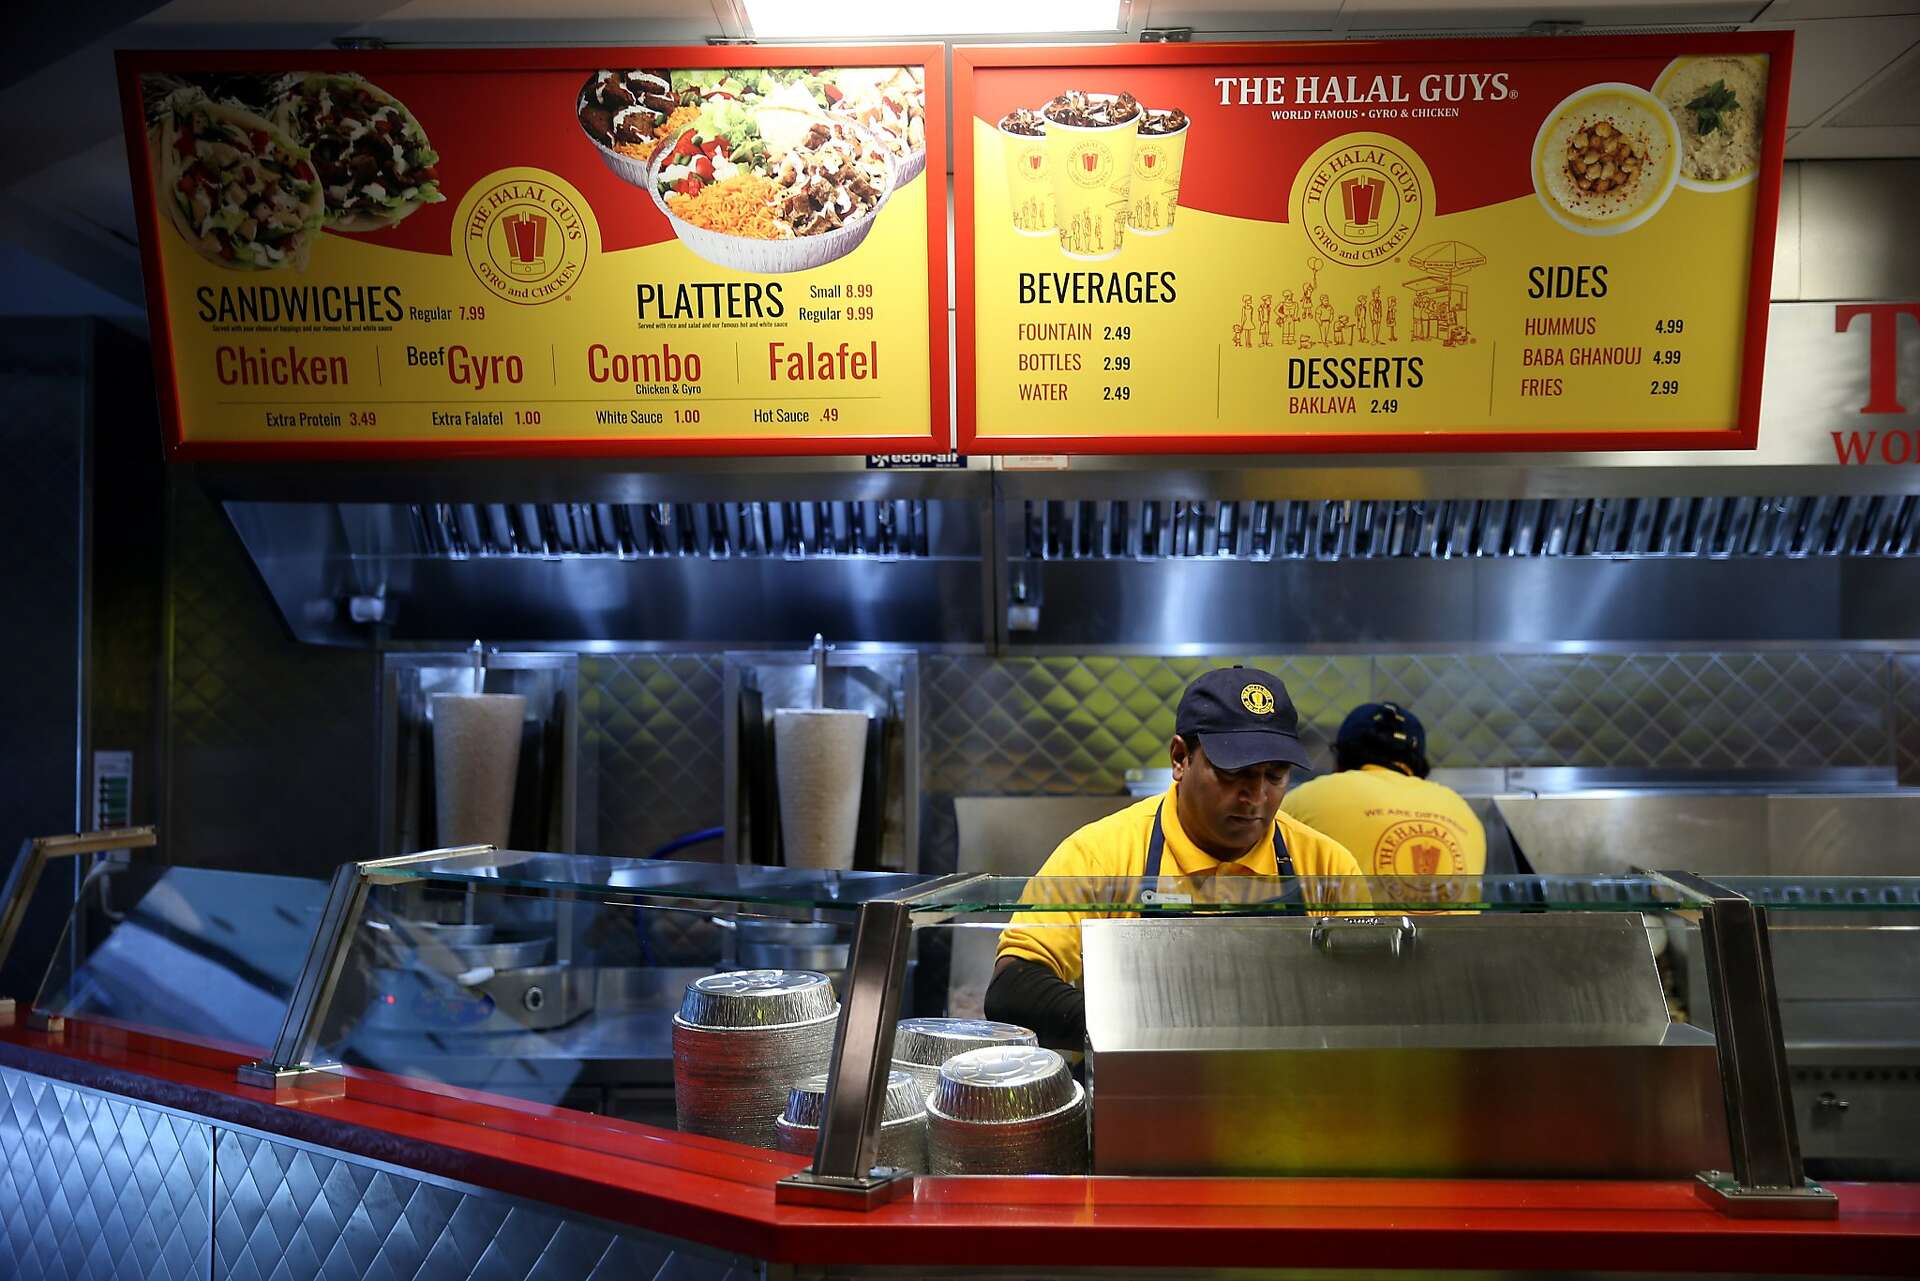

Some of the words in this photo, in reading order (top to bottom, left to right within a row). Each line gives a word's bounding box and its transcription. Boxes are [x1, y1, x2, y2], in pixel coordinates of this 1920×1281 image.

[1214, 76, 1285, 105] THE
[1295, 75, 1409, 104] HALAL
[1272, 110, 1311, 120] WORLD
[1314, 109, 1358, 119] FAMOUS
[1368, 109, 1397, 118] GYRO
[1400, 109, 1408, 118] &
[1412, 108, 1459, 118] CHICKEN
[1308, 170, 1331, 204] THE
[1329, 150, 1387, 173] HALAL
[1390, 162, 1417, 203] GUYS
[470, 205, 491, 240] THE
[488, 186, 546, 209] HALAL
[550, 198, 582, 241] GUYS
[1313, 225, 1339, 253] GYRO
[1340, 250, 1359, 260] and
[1362, 224, 1409, 260] CHICKEN
[480, 262, 506, 290] GYRO
[508, 288, 528, 298] and
[531, 261, 577, 298] CHICKEN
[1019, 271, 1177, 304] BEVERAGES
[1528, 265, 1608, 299] SIDES
[637, 282, 785, 319] PLATTERS
[810, 285, 841, 298] Small
[846, 285, 873, 298] 8.99
[198, 286, 404, 323] SANDWICHES
[410, 307, 452, 323] Regular
[458, 306, 485, 320] 7.99
[799, 307, 842, 322] Regular
[847, 307, 874, 320] 9.99
[1018, 323, 1092, 341] FOUNTAIN
[1104, 326, 1131, 340] 2.49
[1525, 317, 1596, 336] HUMMUS
[1655, 319, 1683, 334] 4.99
[215, 346, 349, 386] Chicken
[588, 343, 701, 383] Combo
[769, 341, 878, 381] Falafel
[1018, 353, 1082, 371] BOTTLES
[1104, 356, 1130, 371] 2.99
[1523, 348, 1564, 366] BABA
[1569, 347, 1642, 366] GHANOUJ
[1653, 350, 1681, 364] 4.99
[407, 346, 445, 366] Beef
[448, 345, 524, 390] Gyro
[1288, 357, 1424, 389] DESSERTS
[635, 383, 670, 394] Chicken
[672, 384, 679, 394] &
[682, 384, 701, 395] Gyro
[1018, 383, 1068, 401] WATER
[1103, 386, 1130, 400] 2.49
[1521, 378, 1563, 396] FRIES
[1650, 380, 1678, 395] 2.99
[1289, 396, 1356, 414] BAKLAVA
[1370, 399, 1398, 414] 2.49
[266, 412, 296, 427] Extra
[300, 412, 341, 426] Protein
[350, 412, 376, 426] 3.49
[432, 411, 462, 426] Extra
[465, 411, 503, 426] Falafel
[515, 411, 541, 425] 1.00
[596, 410, 628, 424] White
[630, 410, 663, 424] Sauce
[674, 409, 700, 424] 1.00
[754, 409, 774, 423] Hot
[776, 408, 809, 423] Sauce
[820, 408, 839, 422] .49
[1830, 429, 1920, 465] WO
[1364, 808, 1384, 816] WE
[1379, 836, 1396, 869] THE
